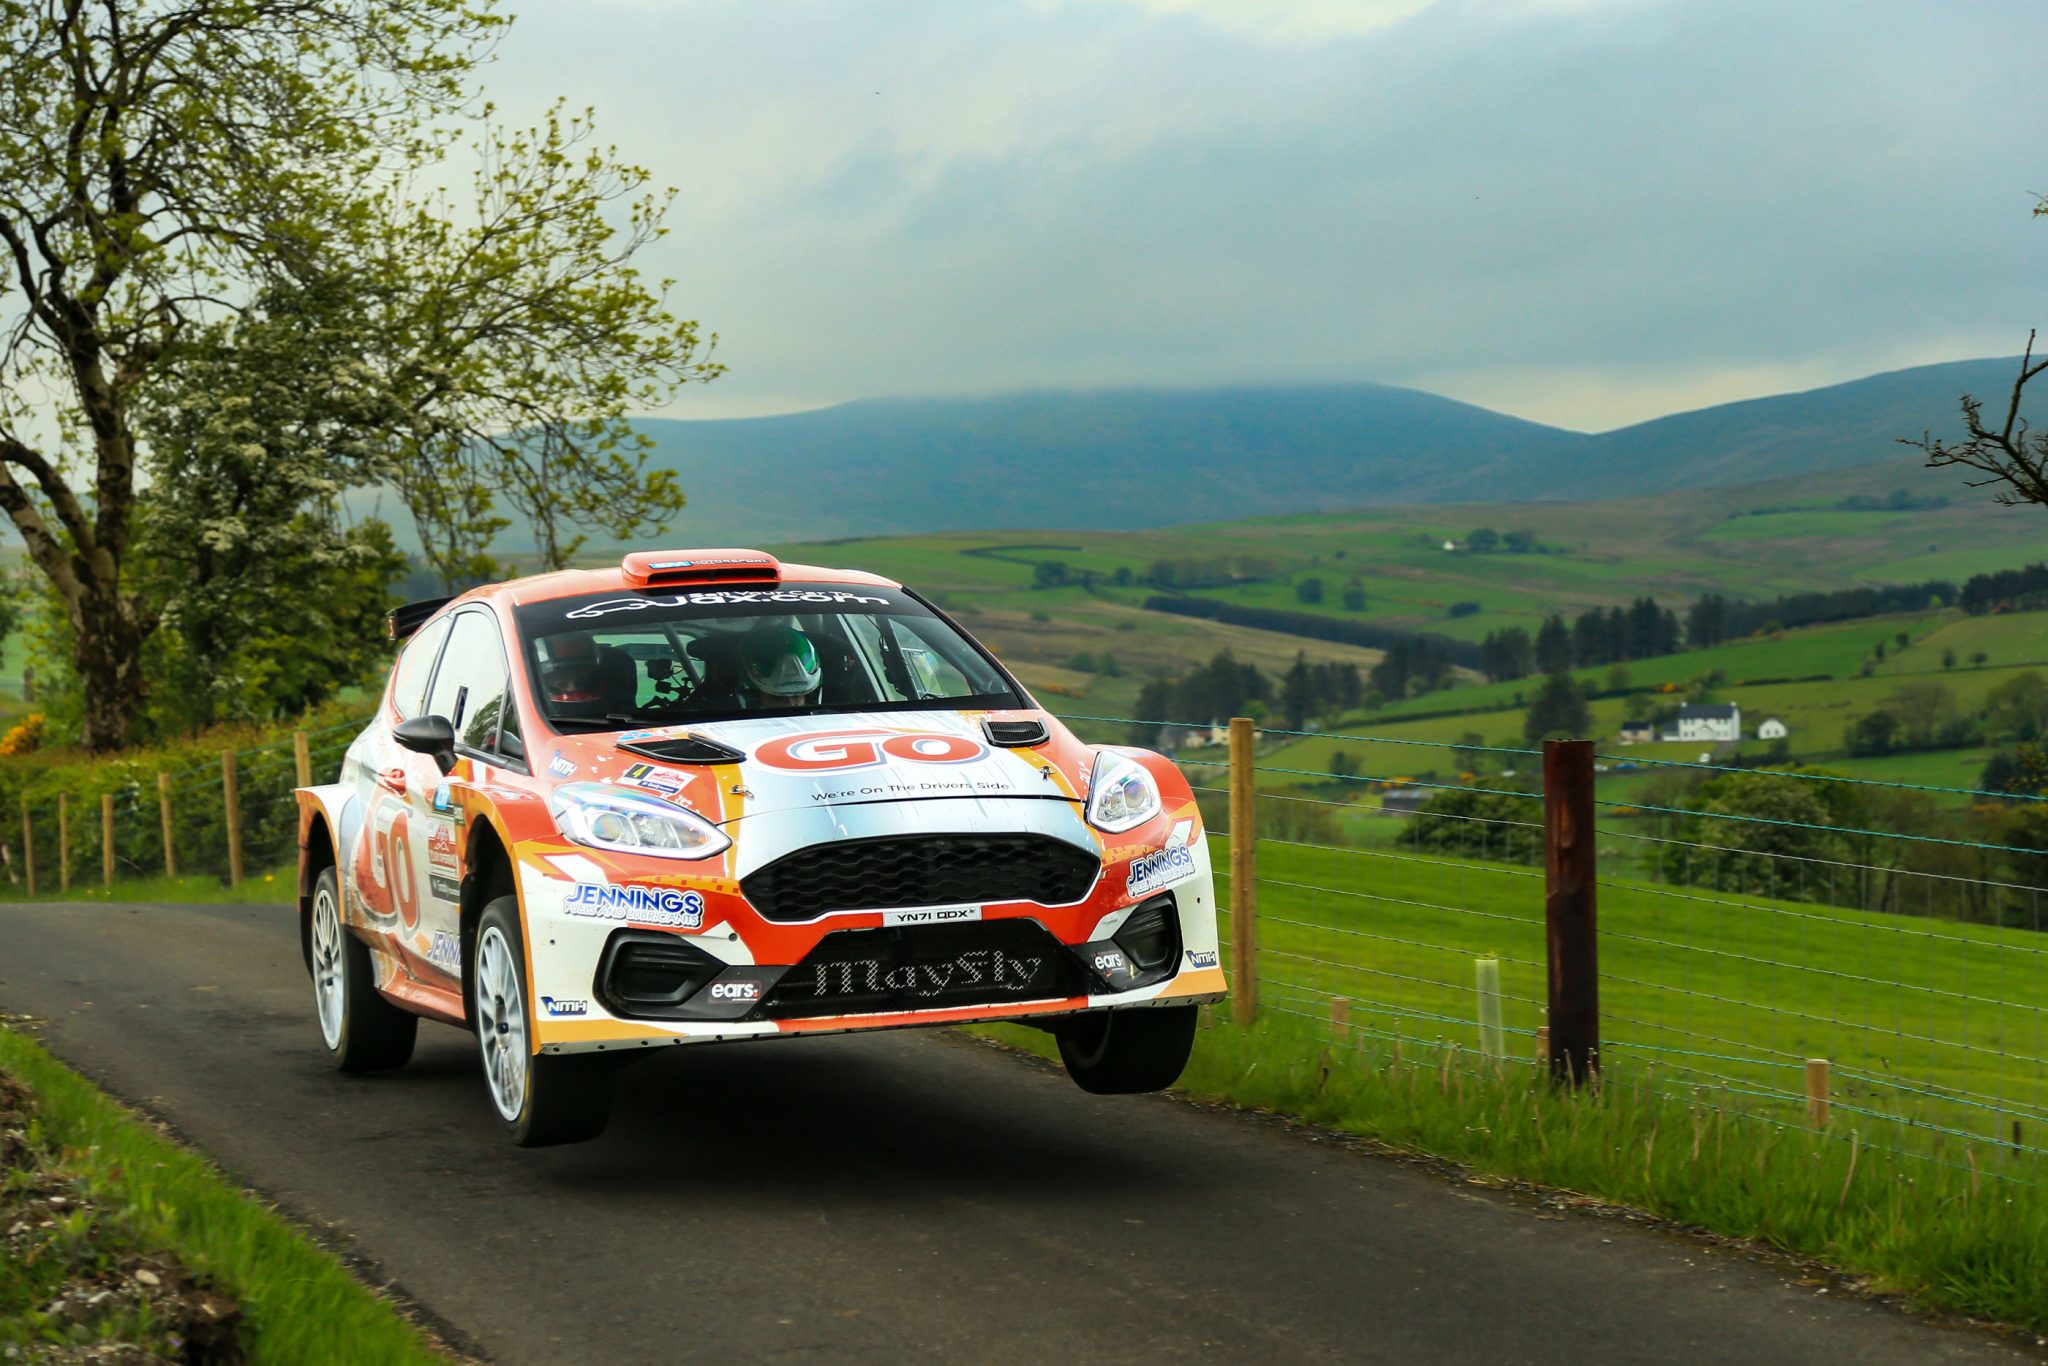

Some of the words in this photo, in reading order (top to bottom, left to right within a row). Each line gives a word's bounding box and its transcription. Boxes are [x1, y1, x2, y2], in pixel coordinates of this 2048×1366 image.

[688, 591, 730, 599] Sell
[752, 728, 984, 771] GO
[631, 764, 648, 779] 4
[811, 789, 855, 801] We're
[860, 787, 883, 795] On
[887, 784, 915, 792] The
[920, 781, 973, 790] Drivers
[977, 782, 1009, 790] Side
[1128, 845, 1190, 885] JENNINGS
[566, 884, 699, 914] JENNINGS
[565, 902, 597, 915] FUELS
[598, 905, 626, 919] AND
[627, 908, 699, 925] LUBRICANTS
[897, 913, 931, 922] YN71
[1094, 953, 1122, 970] ears
